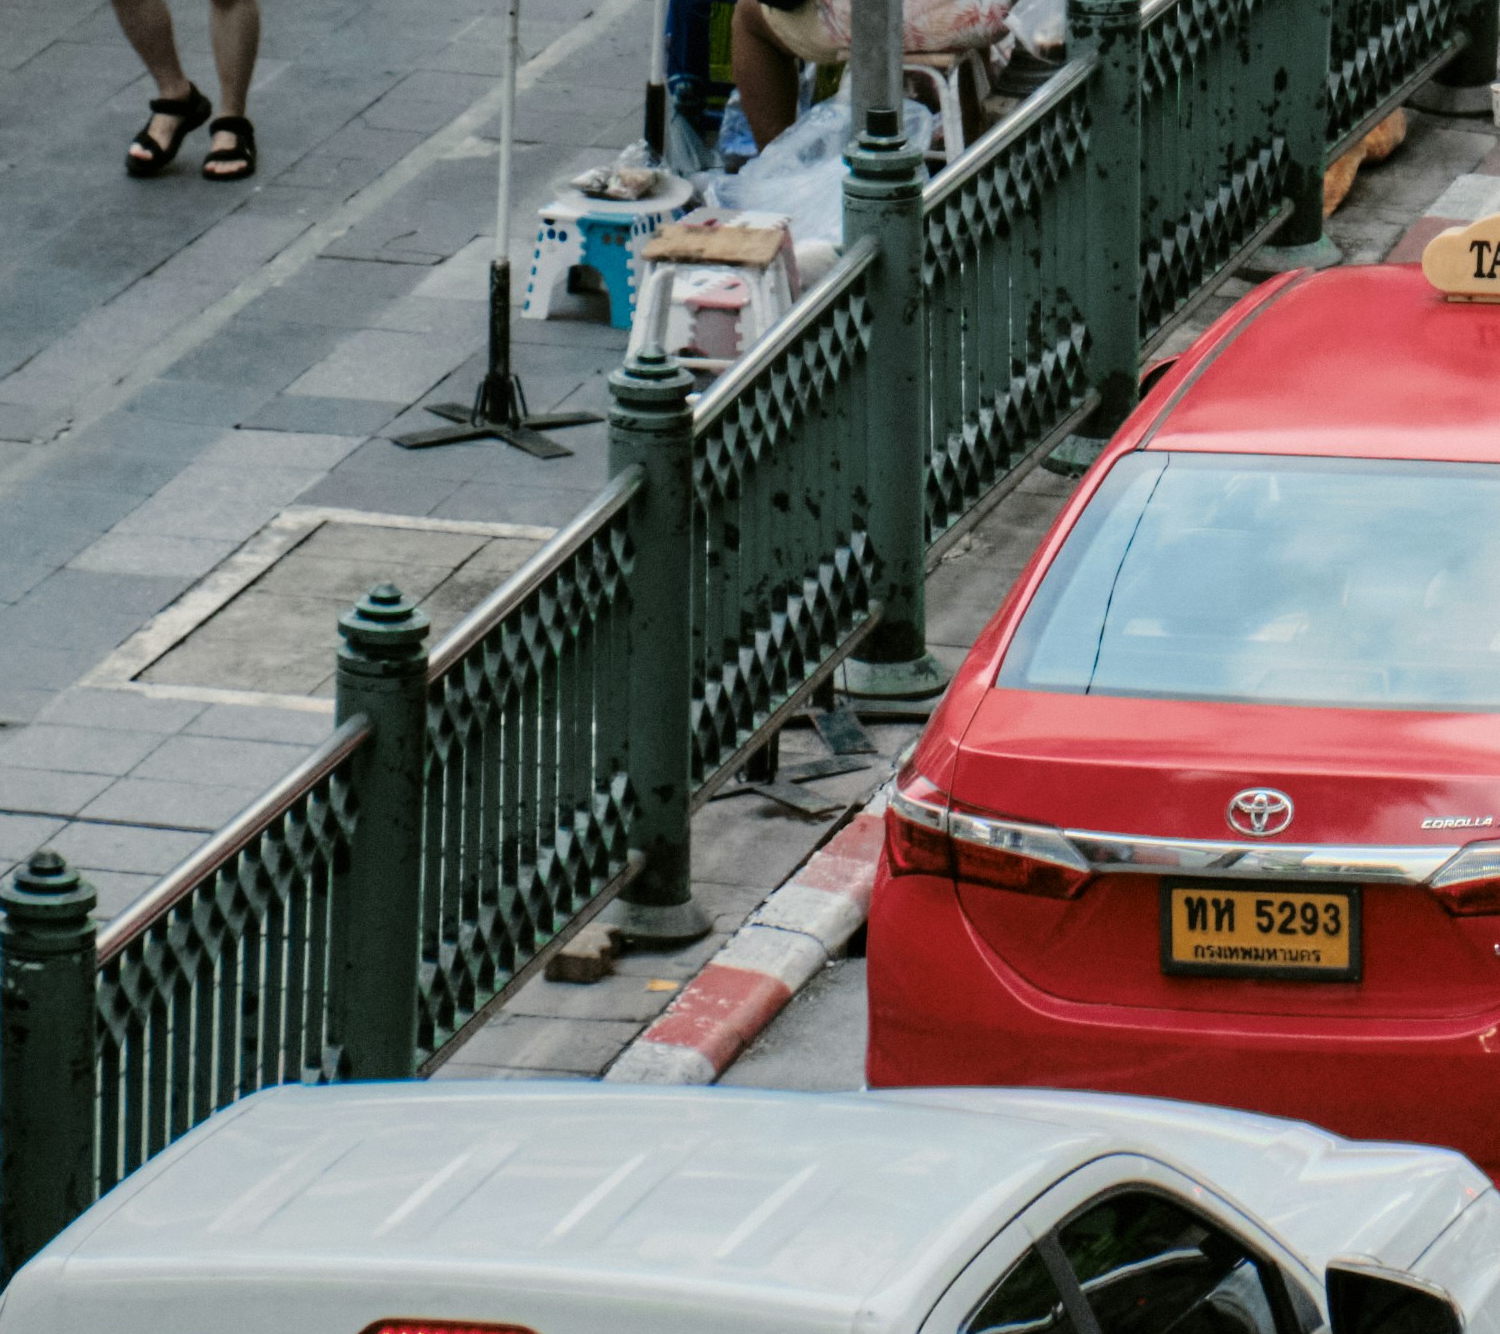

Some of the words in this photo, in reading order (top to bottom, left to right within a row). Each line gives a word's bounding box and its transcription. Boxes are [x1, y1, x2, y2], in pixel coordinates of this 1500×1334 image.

[1420, 816, 1493, 830] COROLLA
[1184, 896, 1235, 932] ทห
[1255, 899, 1342, 936] 5293
